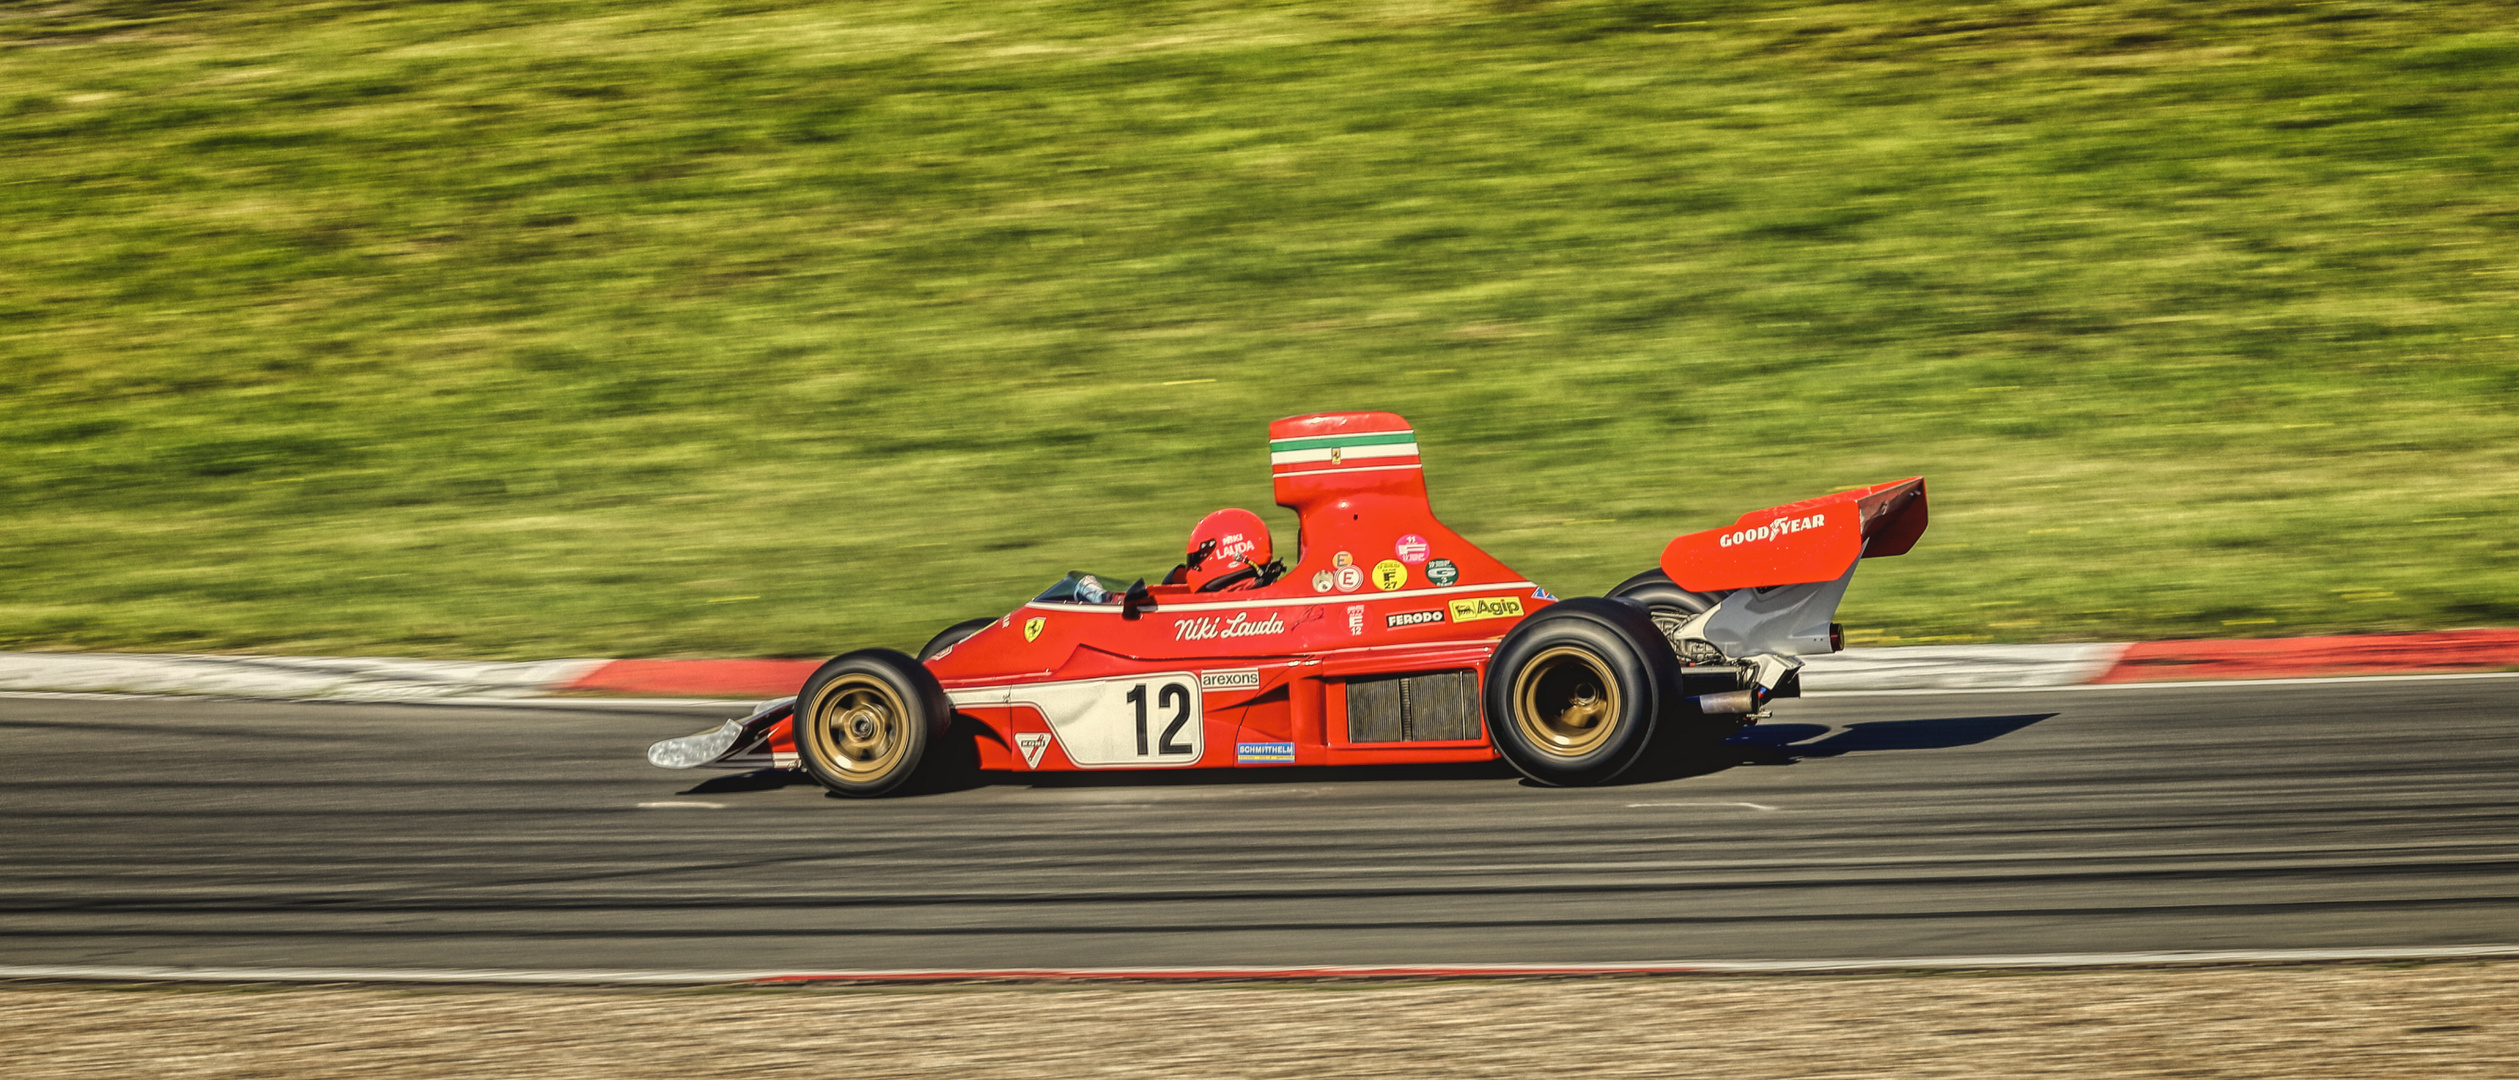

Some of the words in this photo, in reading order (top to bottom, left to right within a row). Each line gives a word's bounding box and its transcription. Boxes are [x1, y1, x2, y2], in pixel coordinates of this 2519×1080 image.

[1216, 540, 1255, 560] LAUDA
[1337, 554, 1348, 567] E
[1343, 571, 1354, 585] E
[1383, 572, 1396, 581] F
[1383, 581, 1397, 590] 27
[1477, 599, 1520, 615] Agip
[1349, 616, 1363, 628] E
[1388, 611, 1443, 627] FERODO
[1174, 616, 1220, 641] Niki
[1220, 612, 1285, 639] Lauda
[1351, 627, 1362, 636] 12
[1203, 673, 1258, 685] arexons
[1126, 683, 1193, 756] 12
[1239, 745, 1293, 753] SCHMITTHELM
